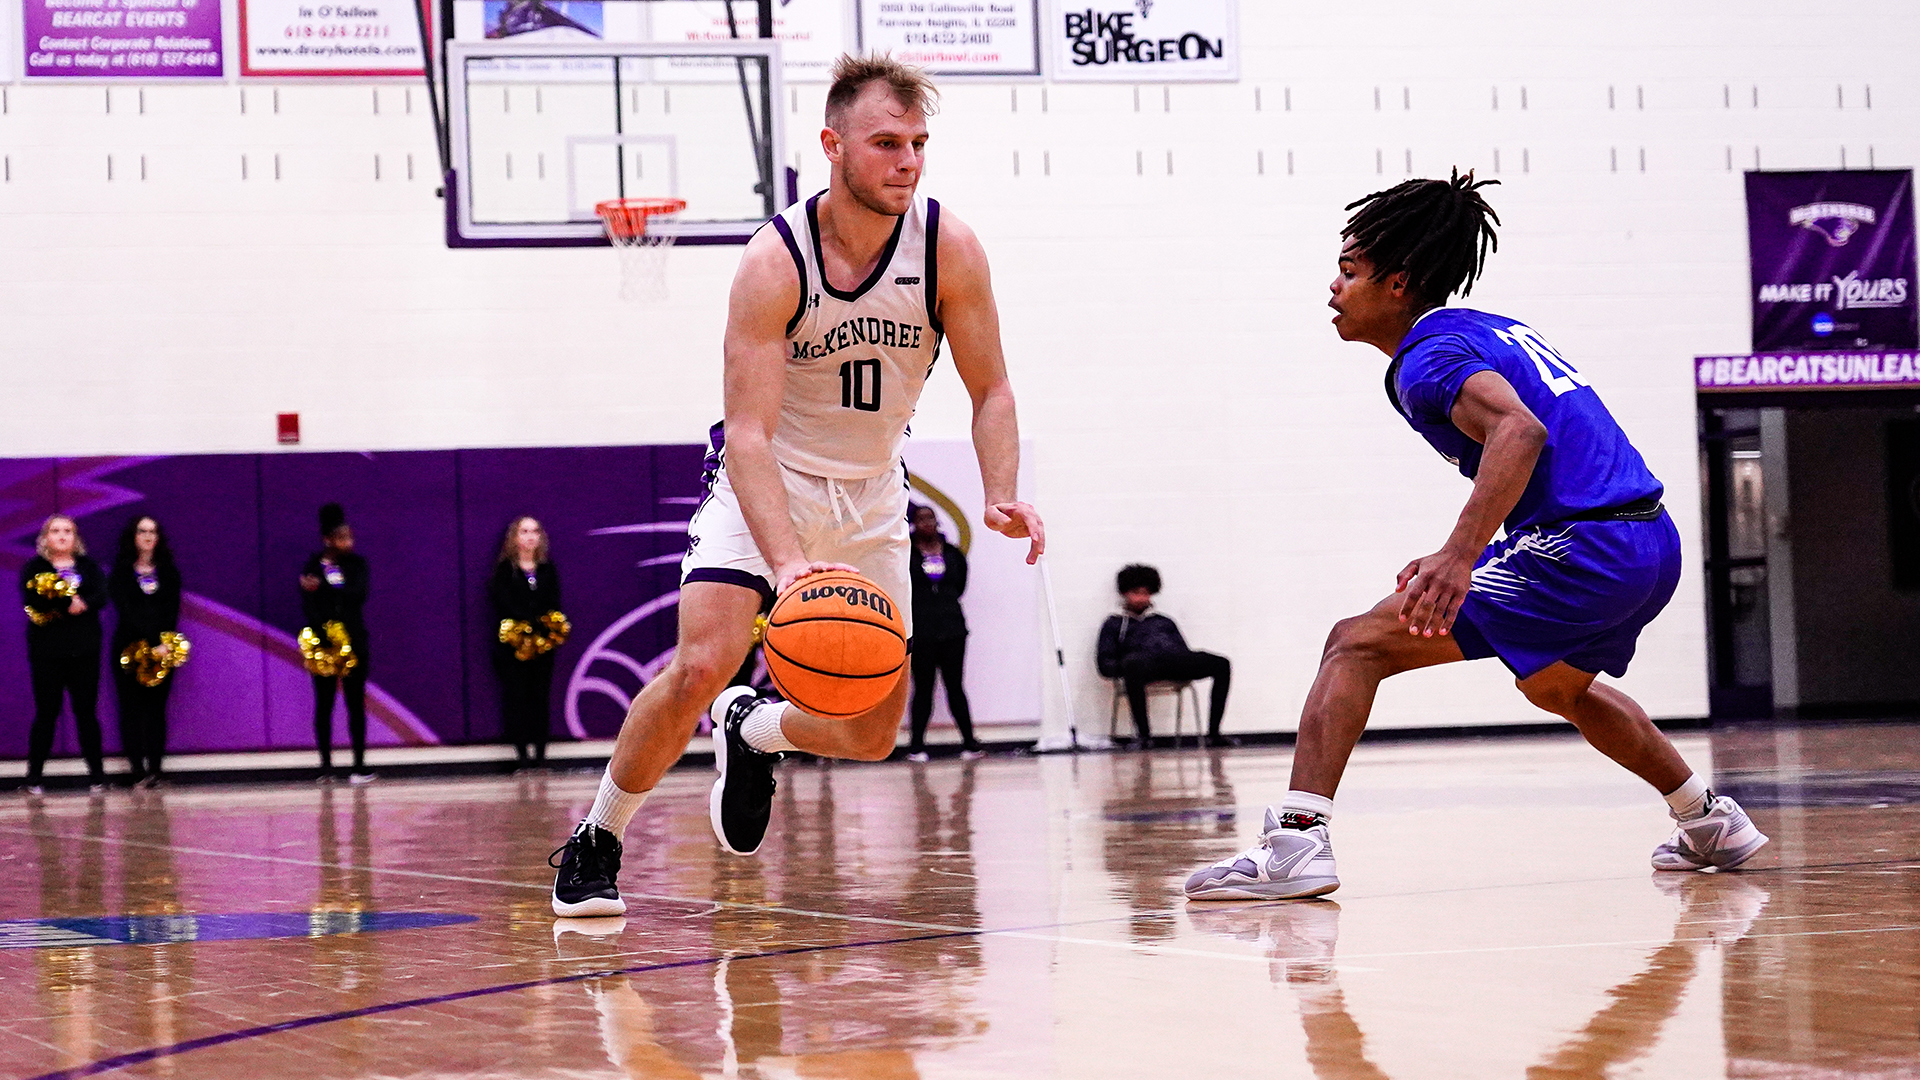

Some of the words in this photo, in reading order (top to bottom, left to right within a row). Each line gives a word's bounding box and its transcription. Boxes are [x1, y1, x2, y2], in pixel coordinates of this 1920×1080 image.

[52, 11, 122, 27] BEARCAT
[125, 11, 187, 27] EVENTS
[1065, 8, 1135, 38] BIKE
[39, 35, 87, 50] Contact
[91, 35, 152, 52] Corporate
[154, 35, 212, 50] Relations
[1072, 31, 1224, 65] SURGEON
[29, 52, 54, 67] Call
[55, 54, 72, 67] us
[74, 52, 109, 69] today
[111, 53, 126, 67] at
[1758, 284, 1812, 303] MAKE
[1814, 283, 1834, 302] IT
[1831, 270, 1909, 310] YOURS
[839, 358, 882, 412] 10
[801, 585, 893, 621] Wilson
